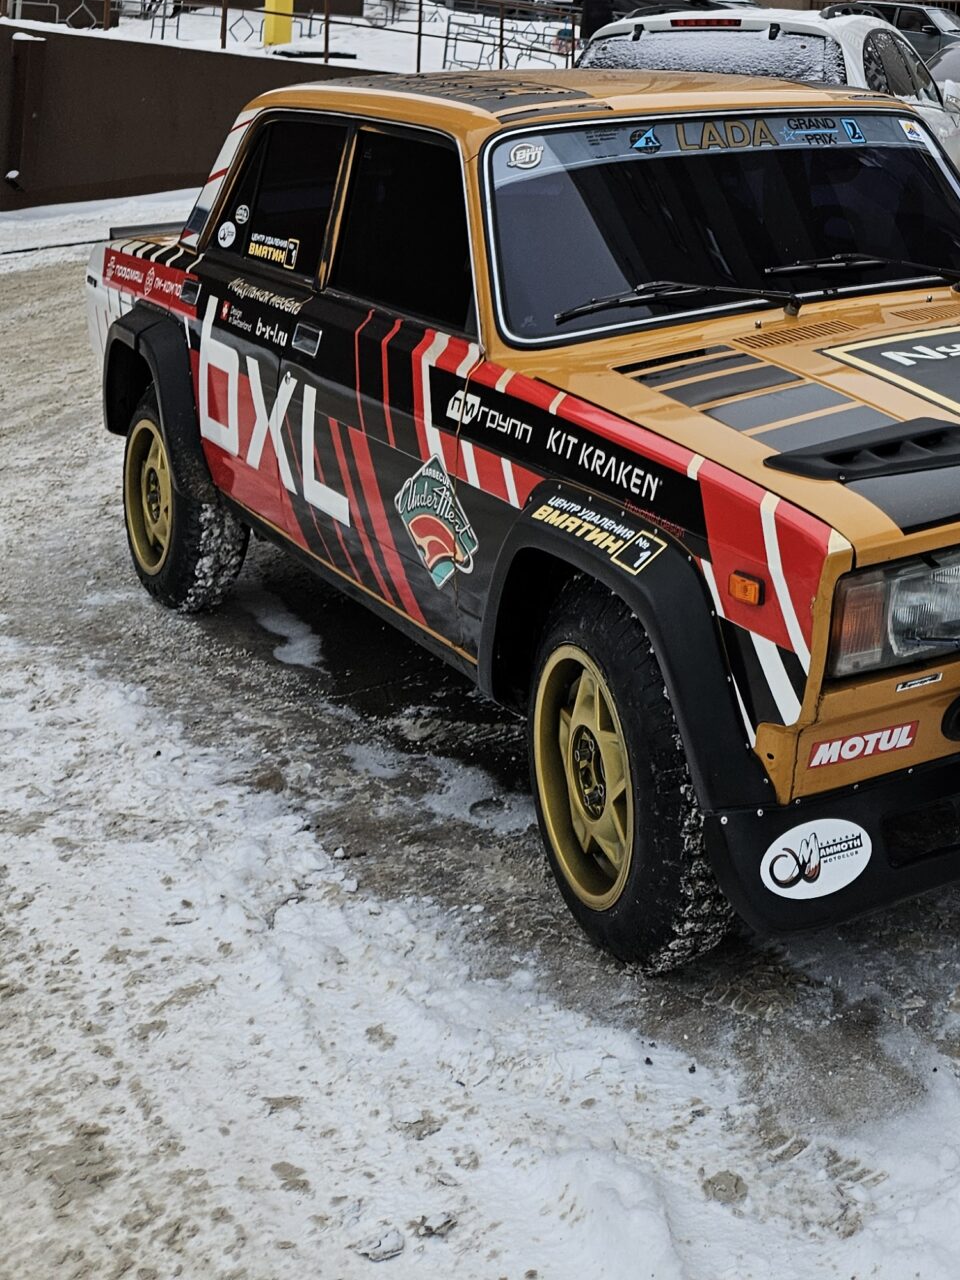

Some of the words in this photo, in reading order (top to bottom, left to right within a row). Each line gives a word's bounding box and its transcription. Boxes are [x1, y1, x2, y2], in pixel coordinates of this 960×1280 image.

[675, 120, 779, 151] LADA
[787, 117, 836, 131] GRAND
[248, 242, 286, 263] ВМЯТИН
[422, 468, 450, 487] BARBECUE
[546, 427, 578, 460] KIT
[578, 446, 660, 502] KRAKEN
[531, 504, 625, 554] ВМЯТИН
[548, 496, 582, 513] ЦЕНТР
[577, 508, 635, 540] УДАЛЕНИЯ
[635, 537, 650, 550] №
[633, 551, 652, 568] 1
[810, 725, 913, 767] MOTUL
[799, 832, 863, 868] MAMMOTH
[823, 851, 859, 864] MOTOCLUB
